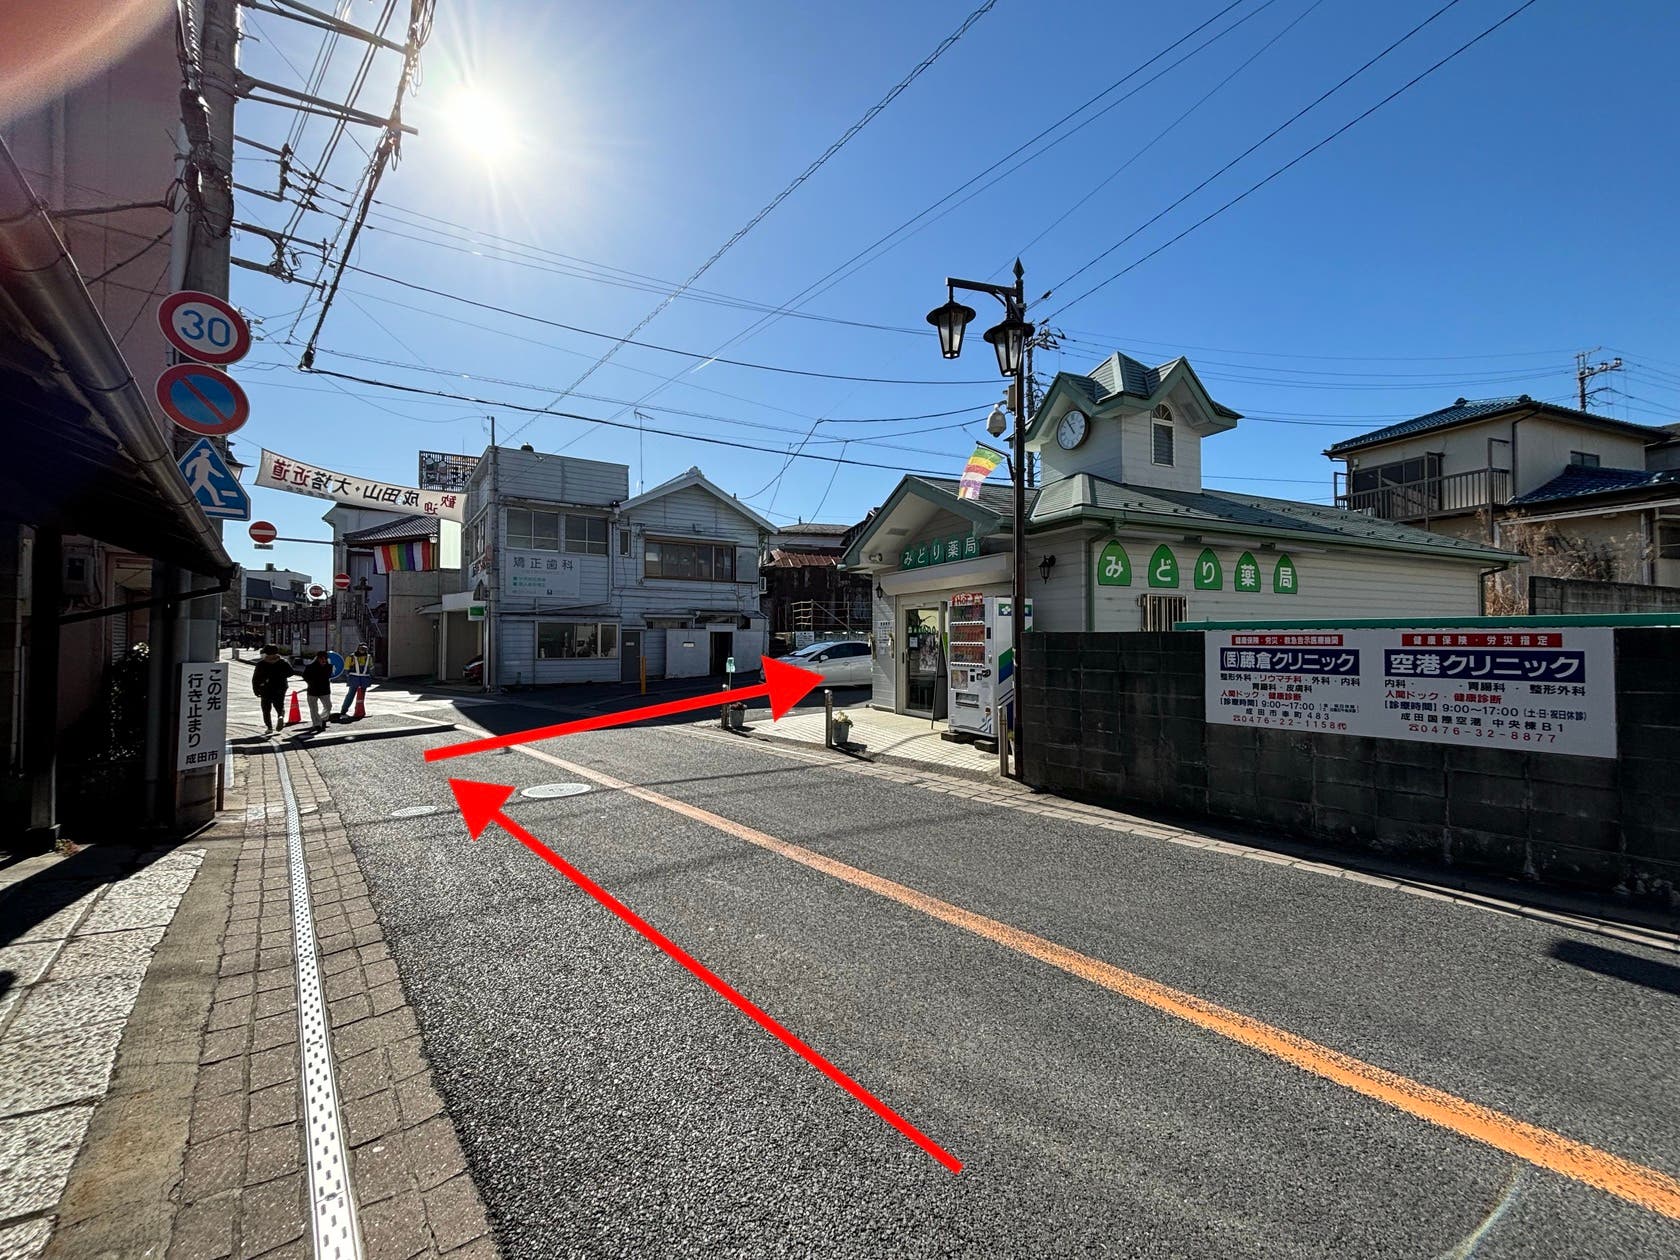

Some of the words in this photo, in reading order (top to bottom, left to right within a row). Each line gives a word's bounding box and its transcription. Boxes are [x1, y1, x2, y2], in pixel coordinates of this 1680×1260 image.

[181, 309, 231, 347] 30
[513, 556, 574, 571] 矯正歯科
[903, 536, 977, 566] みどり薬局
[1105, 556, 1292, 588] みどり薬局
[1391, 653, 1580, 678] 空港クリニック
[207, 669, 222, 711] この先
[187, 673, 203, 748] 行き止まり
[185, 750, 219, 765] 成田市
